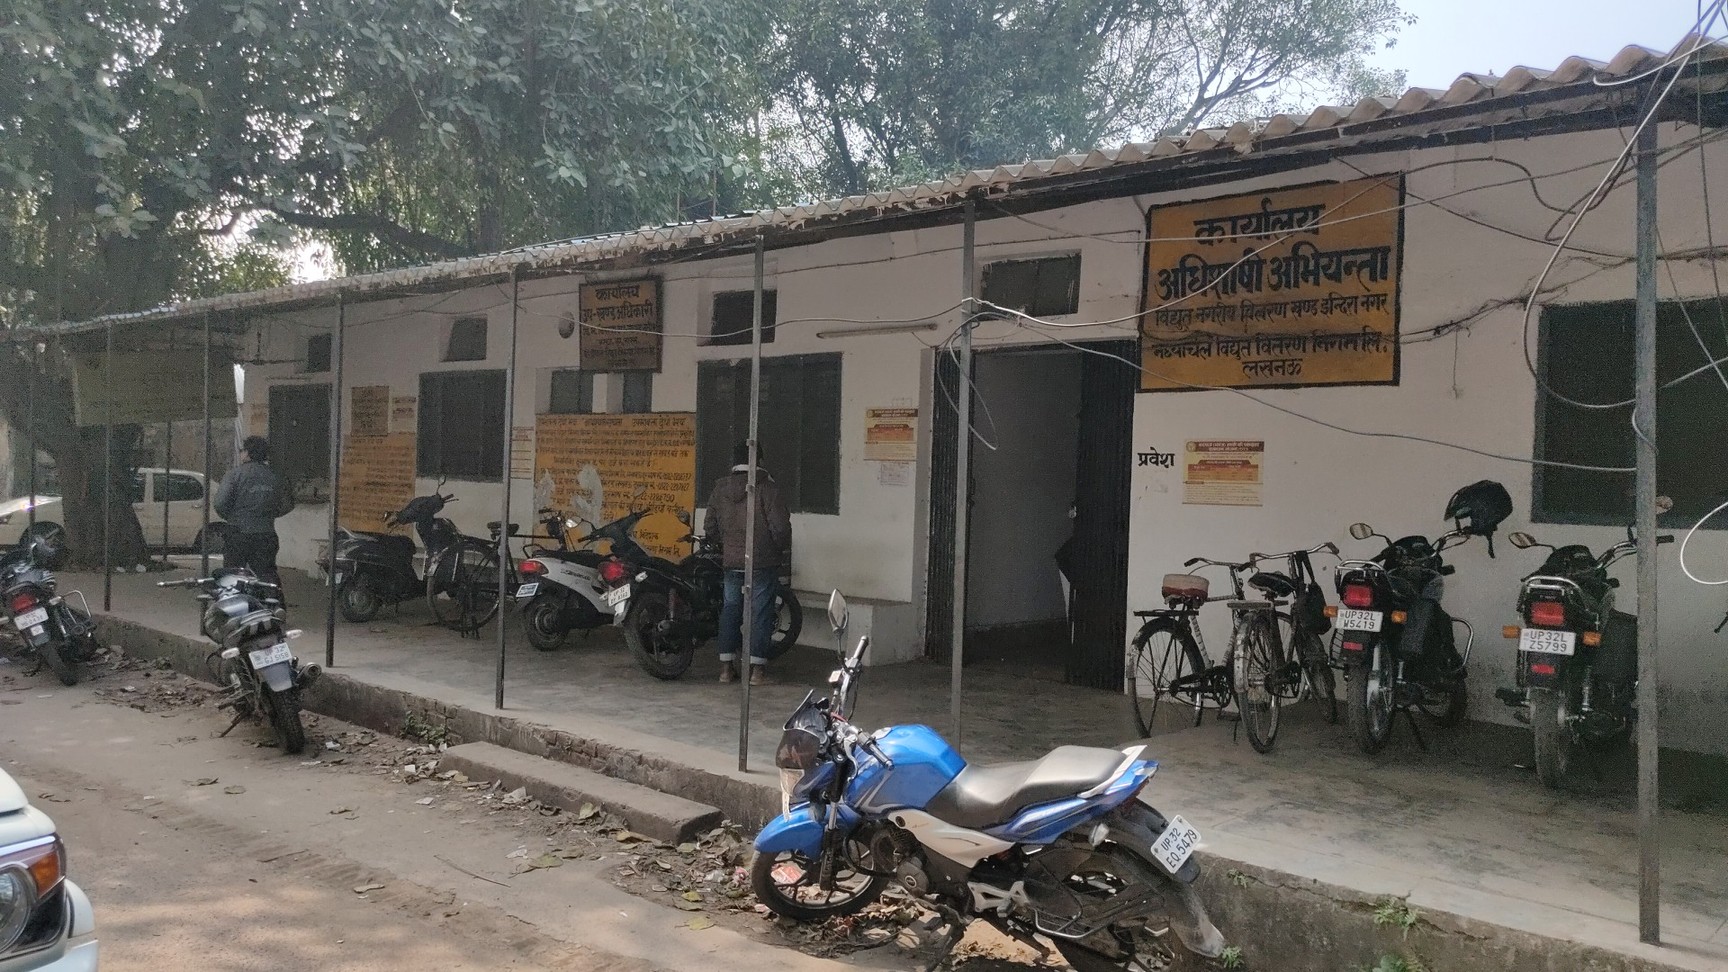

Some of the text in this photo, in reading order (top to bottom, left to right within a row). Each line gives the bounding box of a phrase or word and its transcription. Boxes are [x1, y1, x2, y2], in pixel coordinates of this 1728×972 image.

[1193, 197, 1326, 247] कार्यालय
[1266, 240, 1391, 293] अभियन्ता
[1239, 298, 1289, 323] वितरण
[1290, 299, 1319, 321] खण्ड
[1320, 291, 1359, 318] इन्दिरा
[1360, 293, 1390, 316] नगर
[1256, 333, 1306, 357] वितरण
[1242, 358, 1303, 379] लखनऊ
[1137, 446, 1176, 469] प्रवेश
[1343, 619, 1375, 630] W5419
[1344, 610, 1376, 621] UP32L
[1529, 640, 1567, 652] Z5799
[1530, 630, 1568, 643] UP32L
